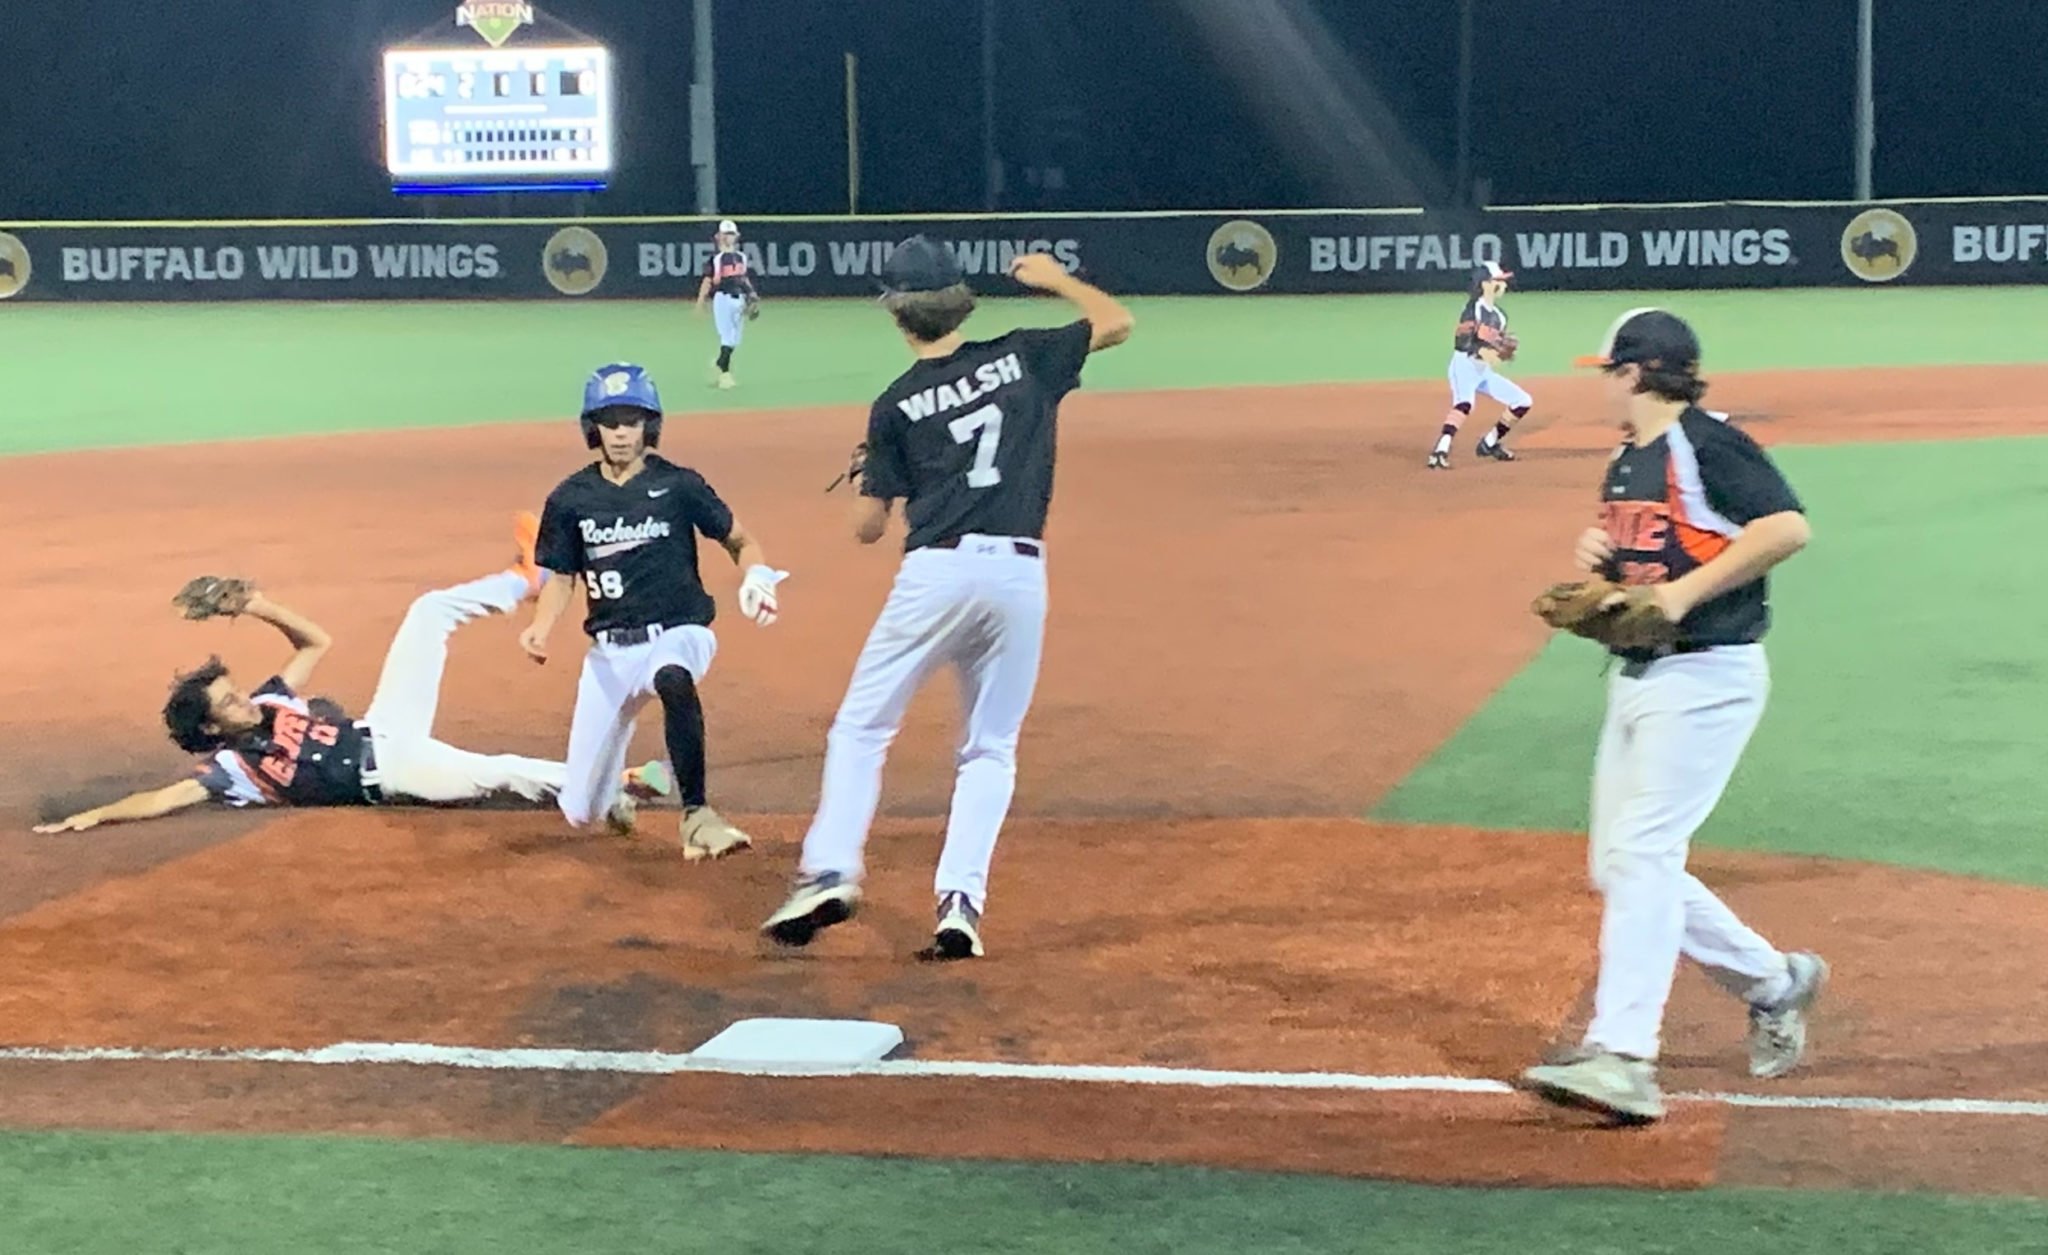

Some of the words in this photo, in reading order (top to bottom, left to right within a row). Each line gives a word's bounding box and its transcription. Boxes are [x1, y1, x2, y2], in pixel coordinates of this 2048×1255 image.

[456, 3, 534, 26] NATION
[638, 241, 816, 277] BUFALO
[1310, 234, 1502, 272] BUFFALO
[1516, 233, 1628, 268] WILD
[1641, 229, 1791, 266] WINGS
[1953, 225, 2048, 262] BUF
[62, 247, 244, 281] BUFFALO
[257, 245, 358, 279] WILD
[368, 244, 499, 278] WINGS
[897, 353, 1022, 422] WALSH
[948, 402, 1003, 488] 7
[579, 516, 670, 544] Rochester
[586, 570, 624, 599] 58
